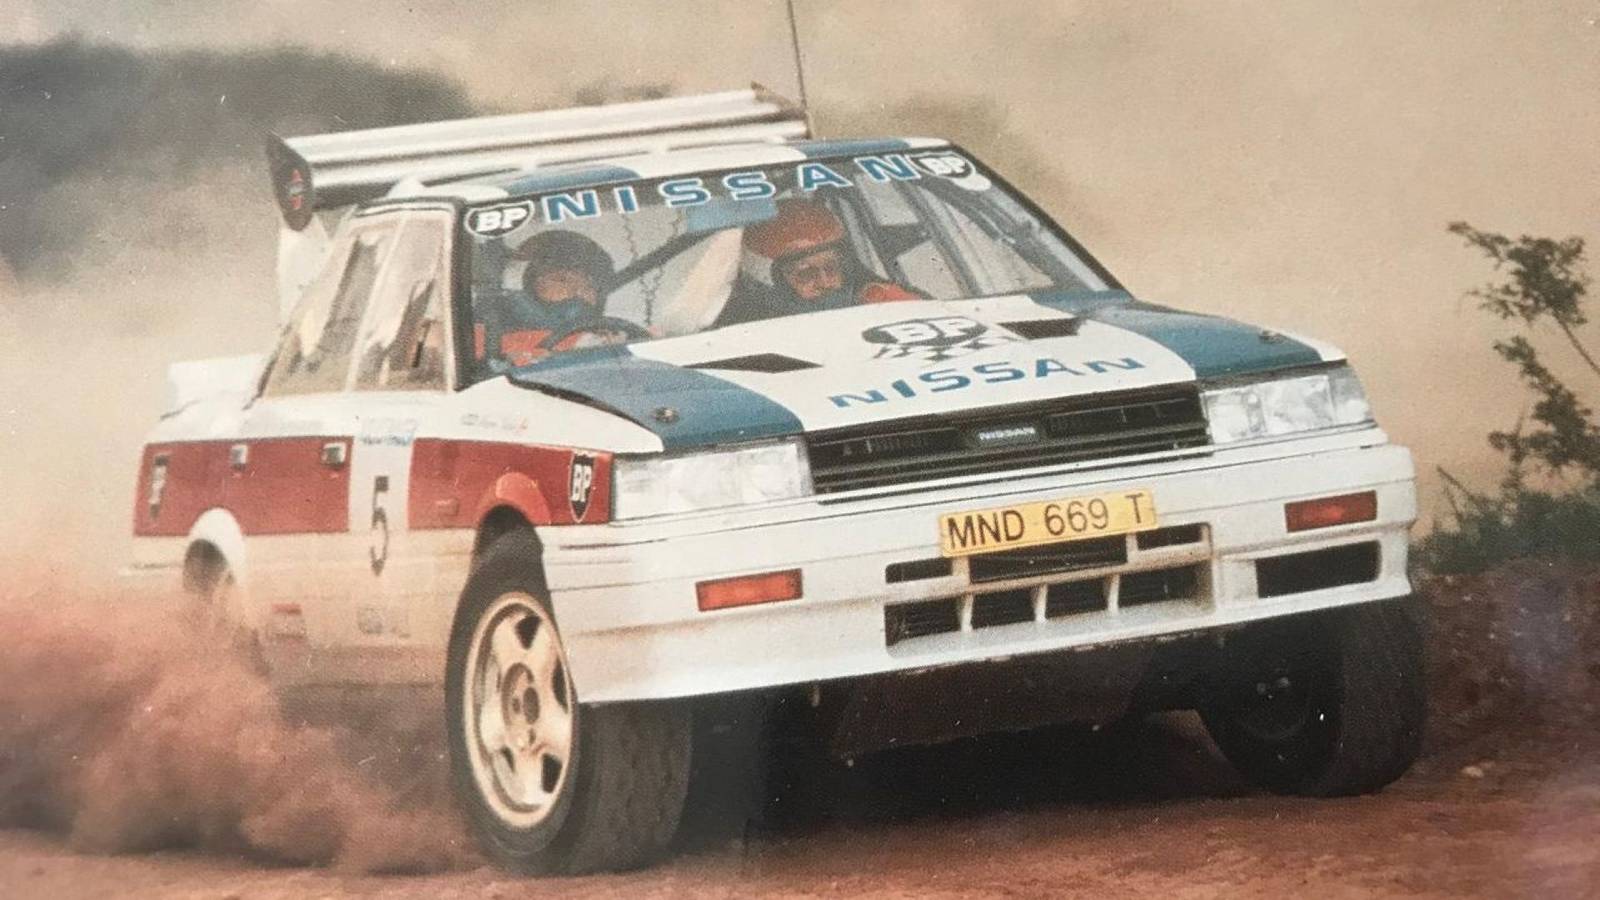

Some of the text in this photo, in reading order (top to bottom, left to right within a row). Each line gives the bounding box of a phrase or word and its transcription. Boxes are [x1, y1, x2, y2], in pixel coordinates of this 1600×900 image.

[918, 156, 966, 175] BP
[541, 154, 921, 224] NISSAN
[474, 207, 528, 232] BP
[882, 315, 982, 343] BP
[828, 356, 1146, 409] NISSAN
[978, 426, 1036, 440] NISSAN
[570, 463, 593, 503] BP
[370, 475, 390, 577] 5
[947, 492, 1145, 550] MND 669 T
